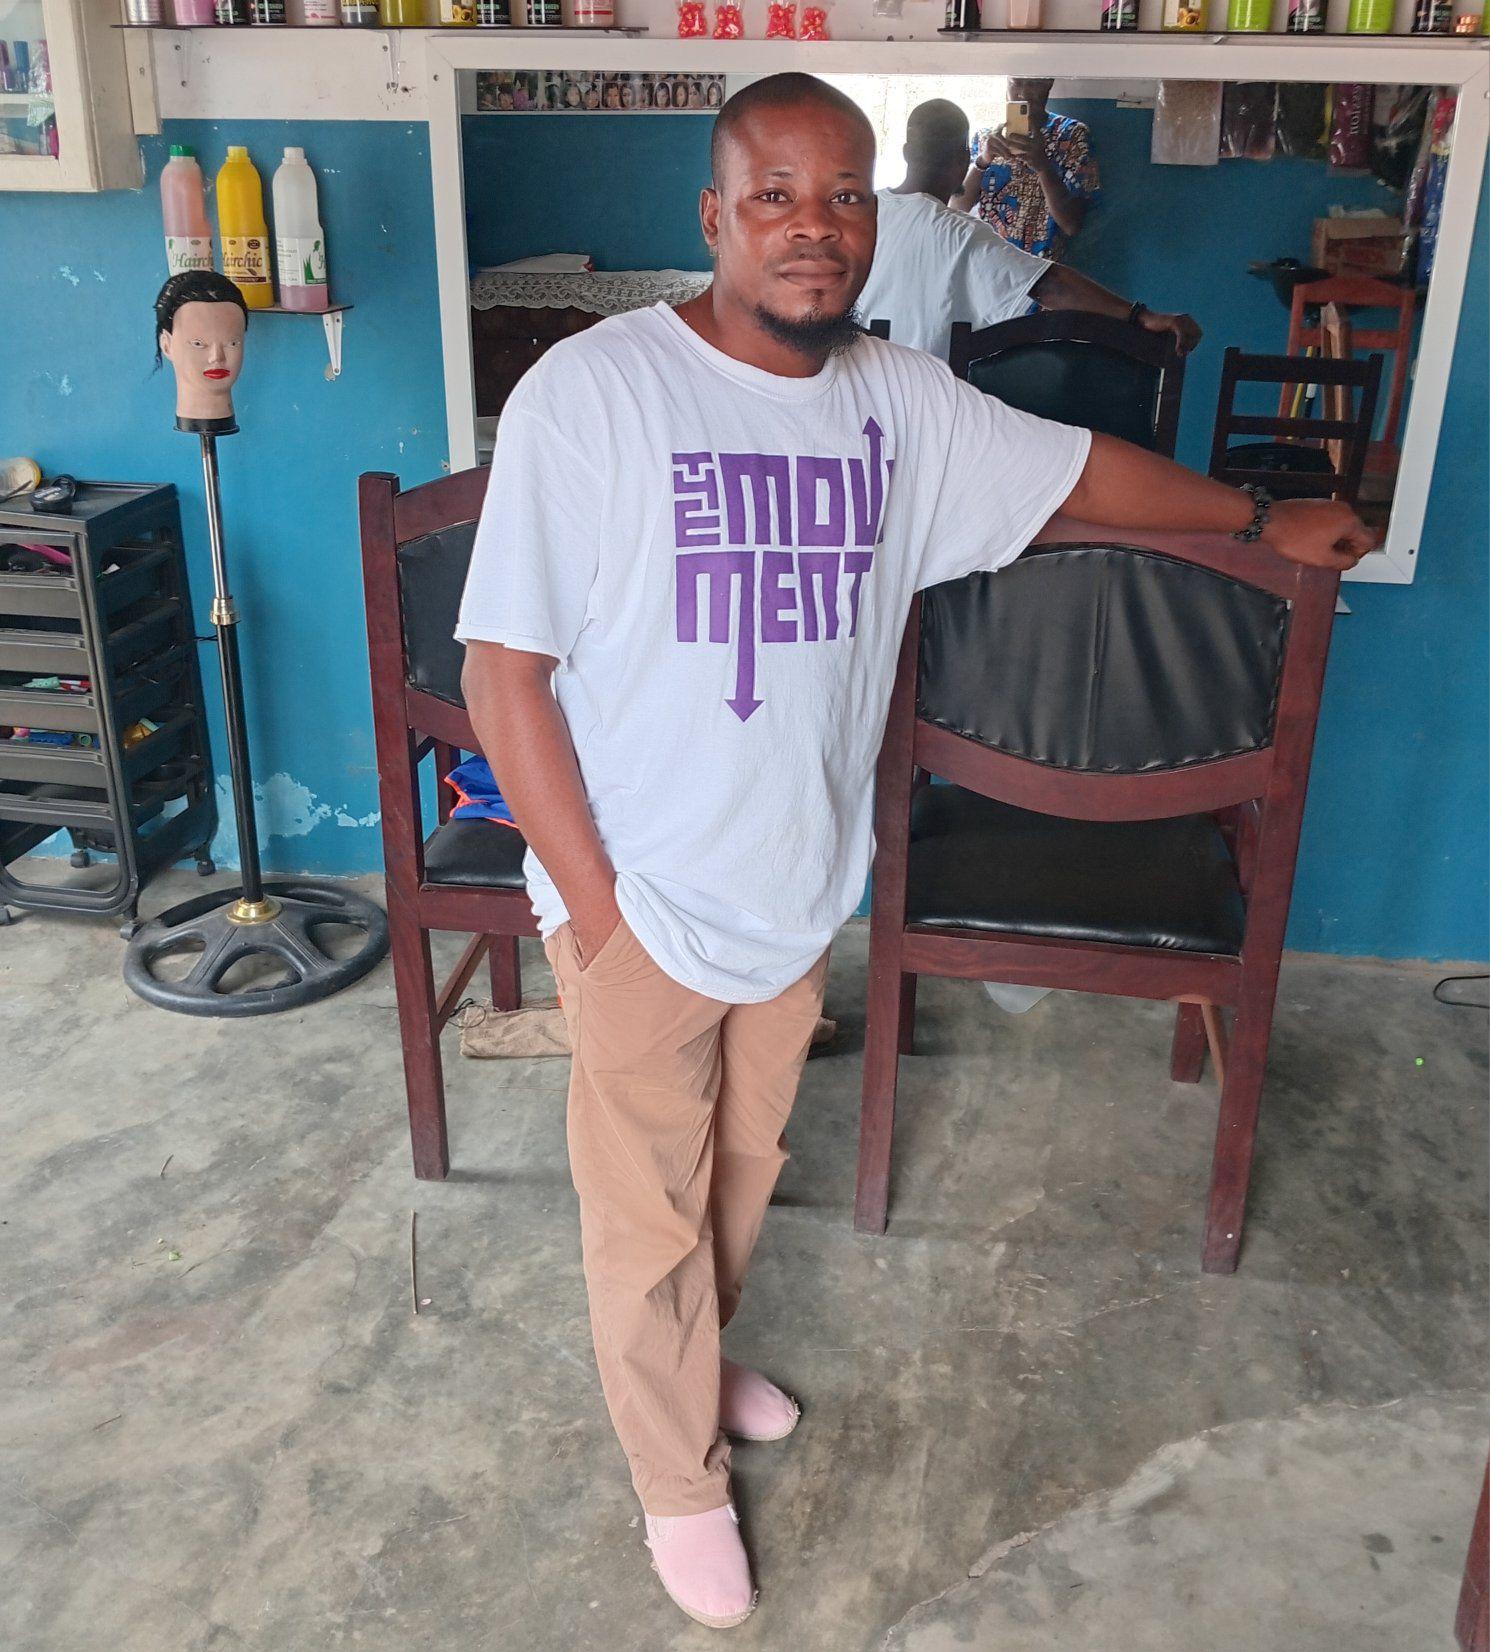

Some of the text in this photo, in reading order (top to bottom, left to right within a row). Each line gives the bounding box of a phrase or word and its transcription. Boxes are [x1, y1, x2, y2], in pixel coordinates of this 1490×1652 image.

[672, 451, 721, 548] THE
[718, 452, 896, 547] MOV
[675, 550, 875, 643] MENT
